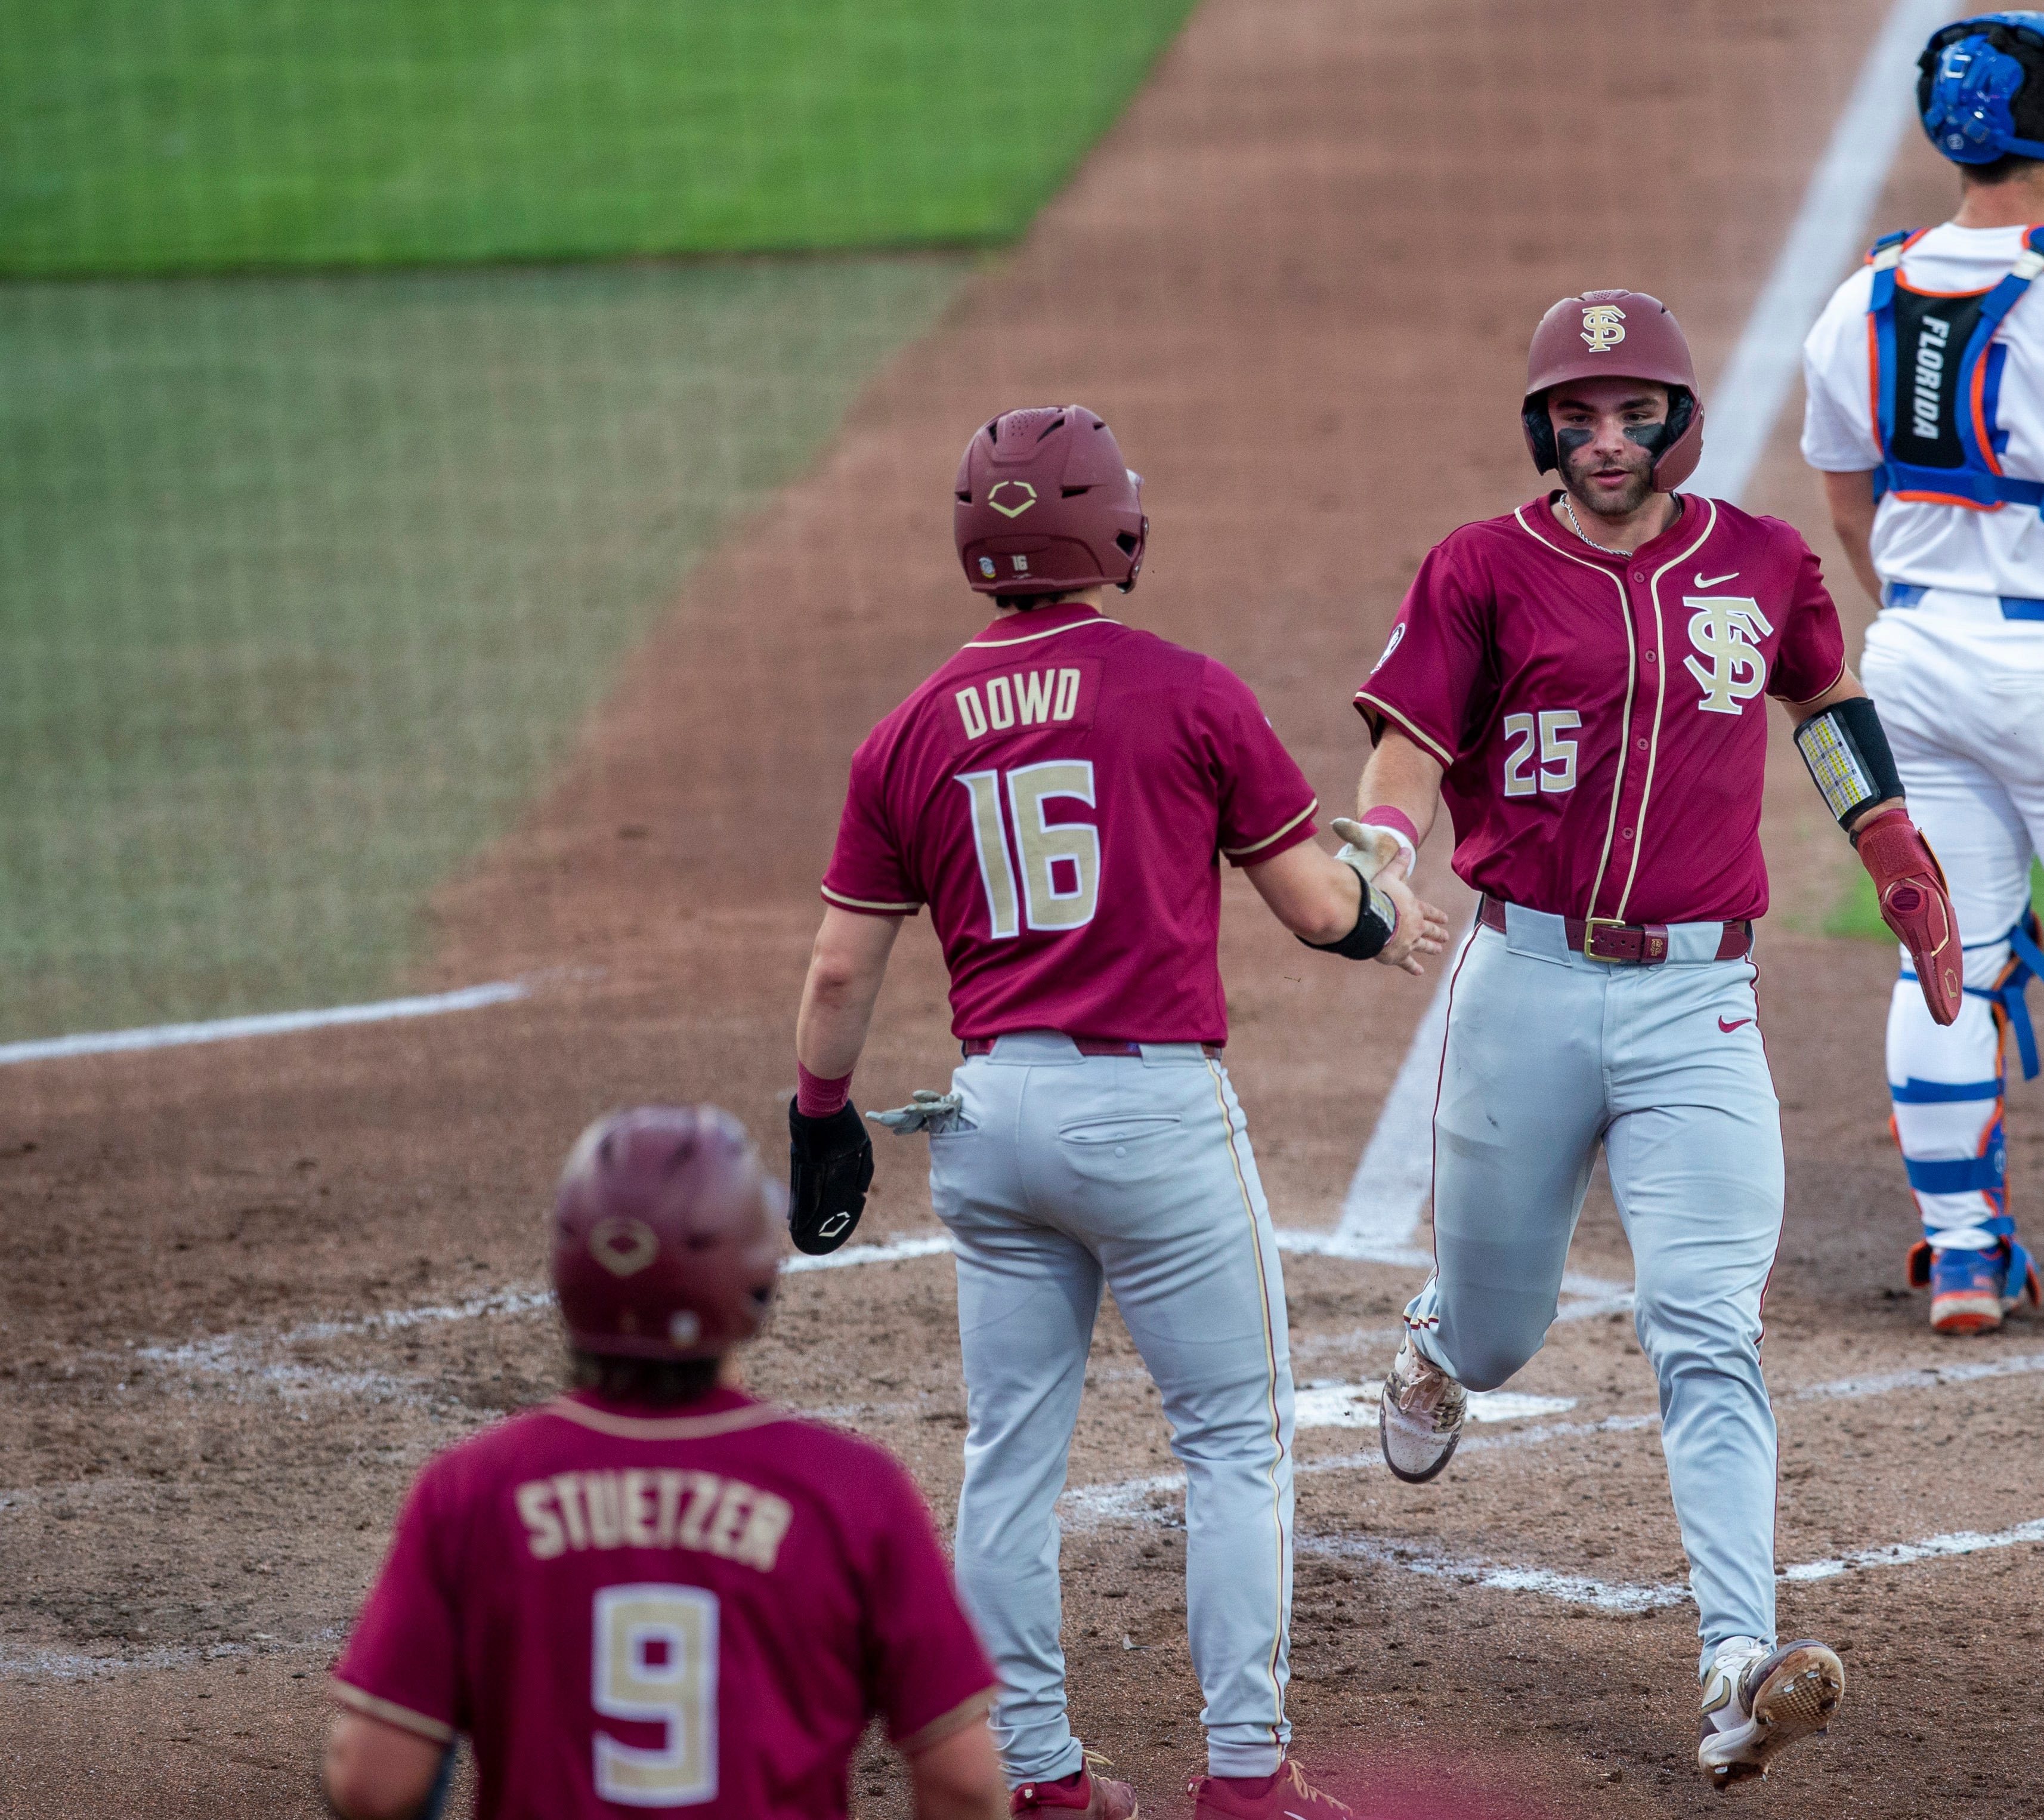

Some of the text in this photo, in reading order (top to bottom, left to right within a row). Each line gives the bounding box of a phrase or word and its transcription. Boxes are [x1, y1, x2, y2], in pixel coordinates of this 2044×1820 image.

[1913, 315, 1951, 440] FLORIDA
[955, 668, 1081, 740] DOWD
[1504, 710, 1582, 796] 25
[953, 759, 1101, 940] 16
[514, 1467, 794, 1574] STUETZER
[590, 1581, 721, 1809] 9
